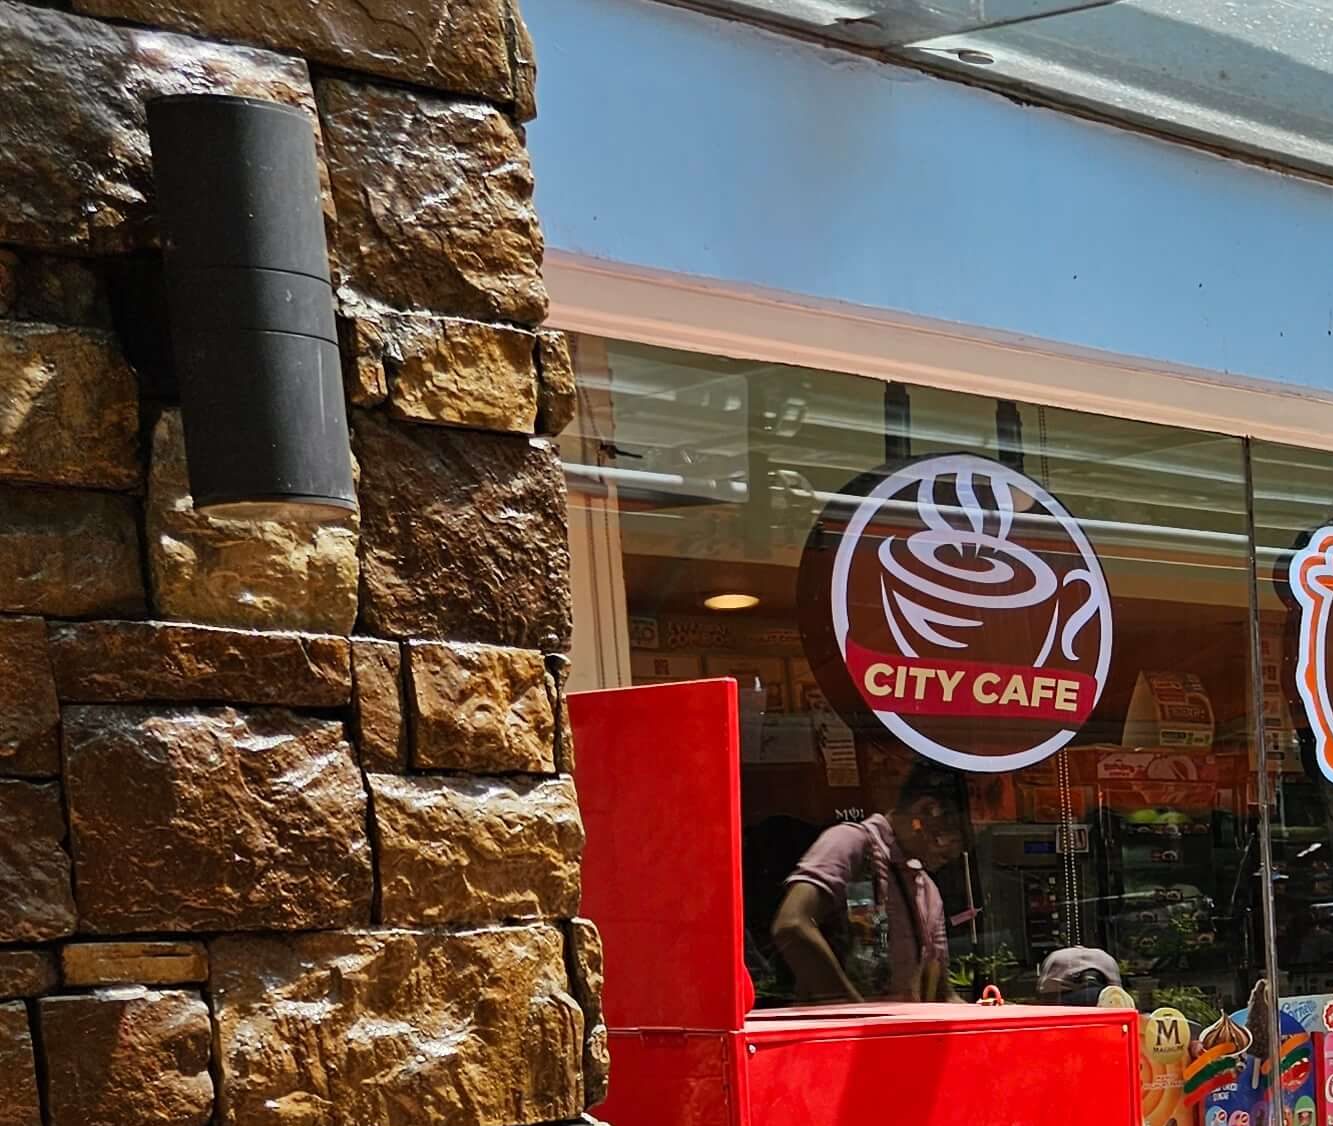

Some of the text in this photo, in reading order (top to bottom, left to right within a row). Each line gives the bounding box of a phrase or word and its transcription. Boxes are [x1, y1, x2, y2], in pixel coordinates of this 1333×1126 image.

[864, 662, 1080, 712] CITY CAFE
[1156, 1019, 1181, 1047] M
